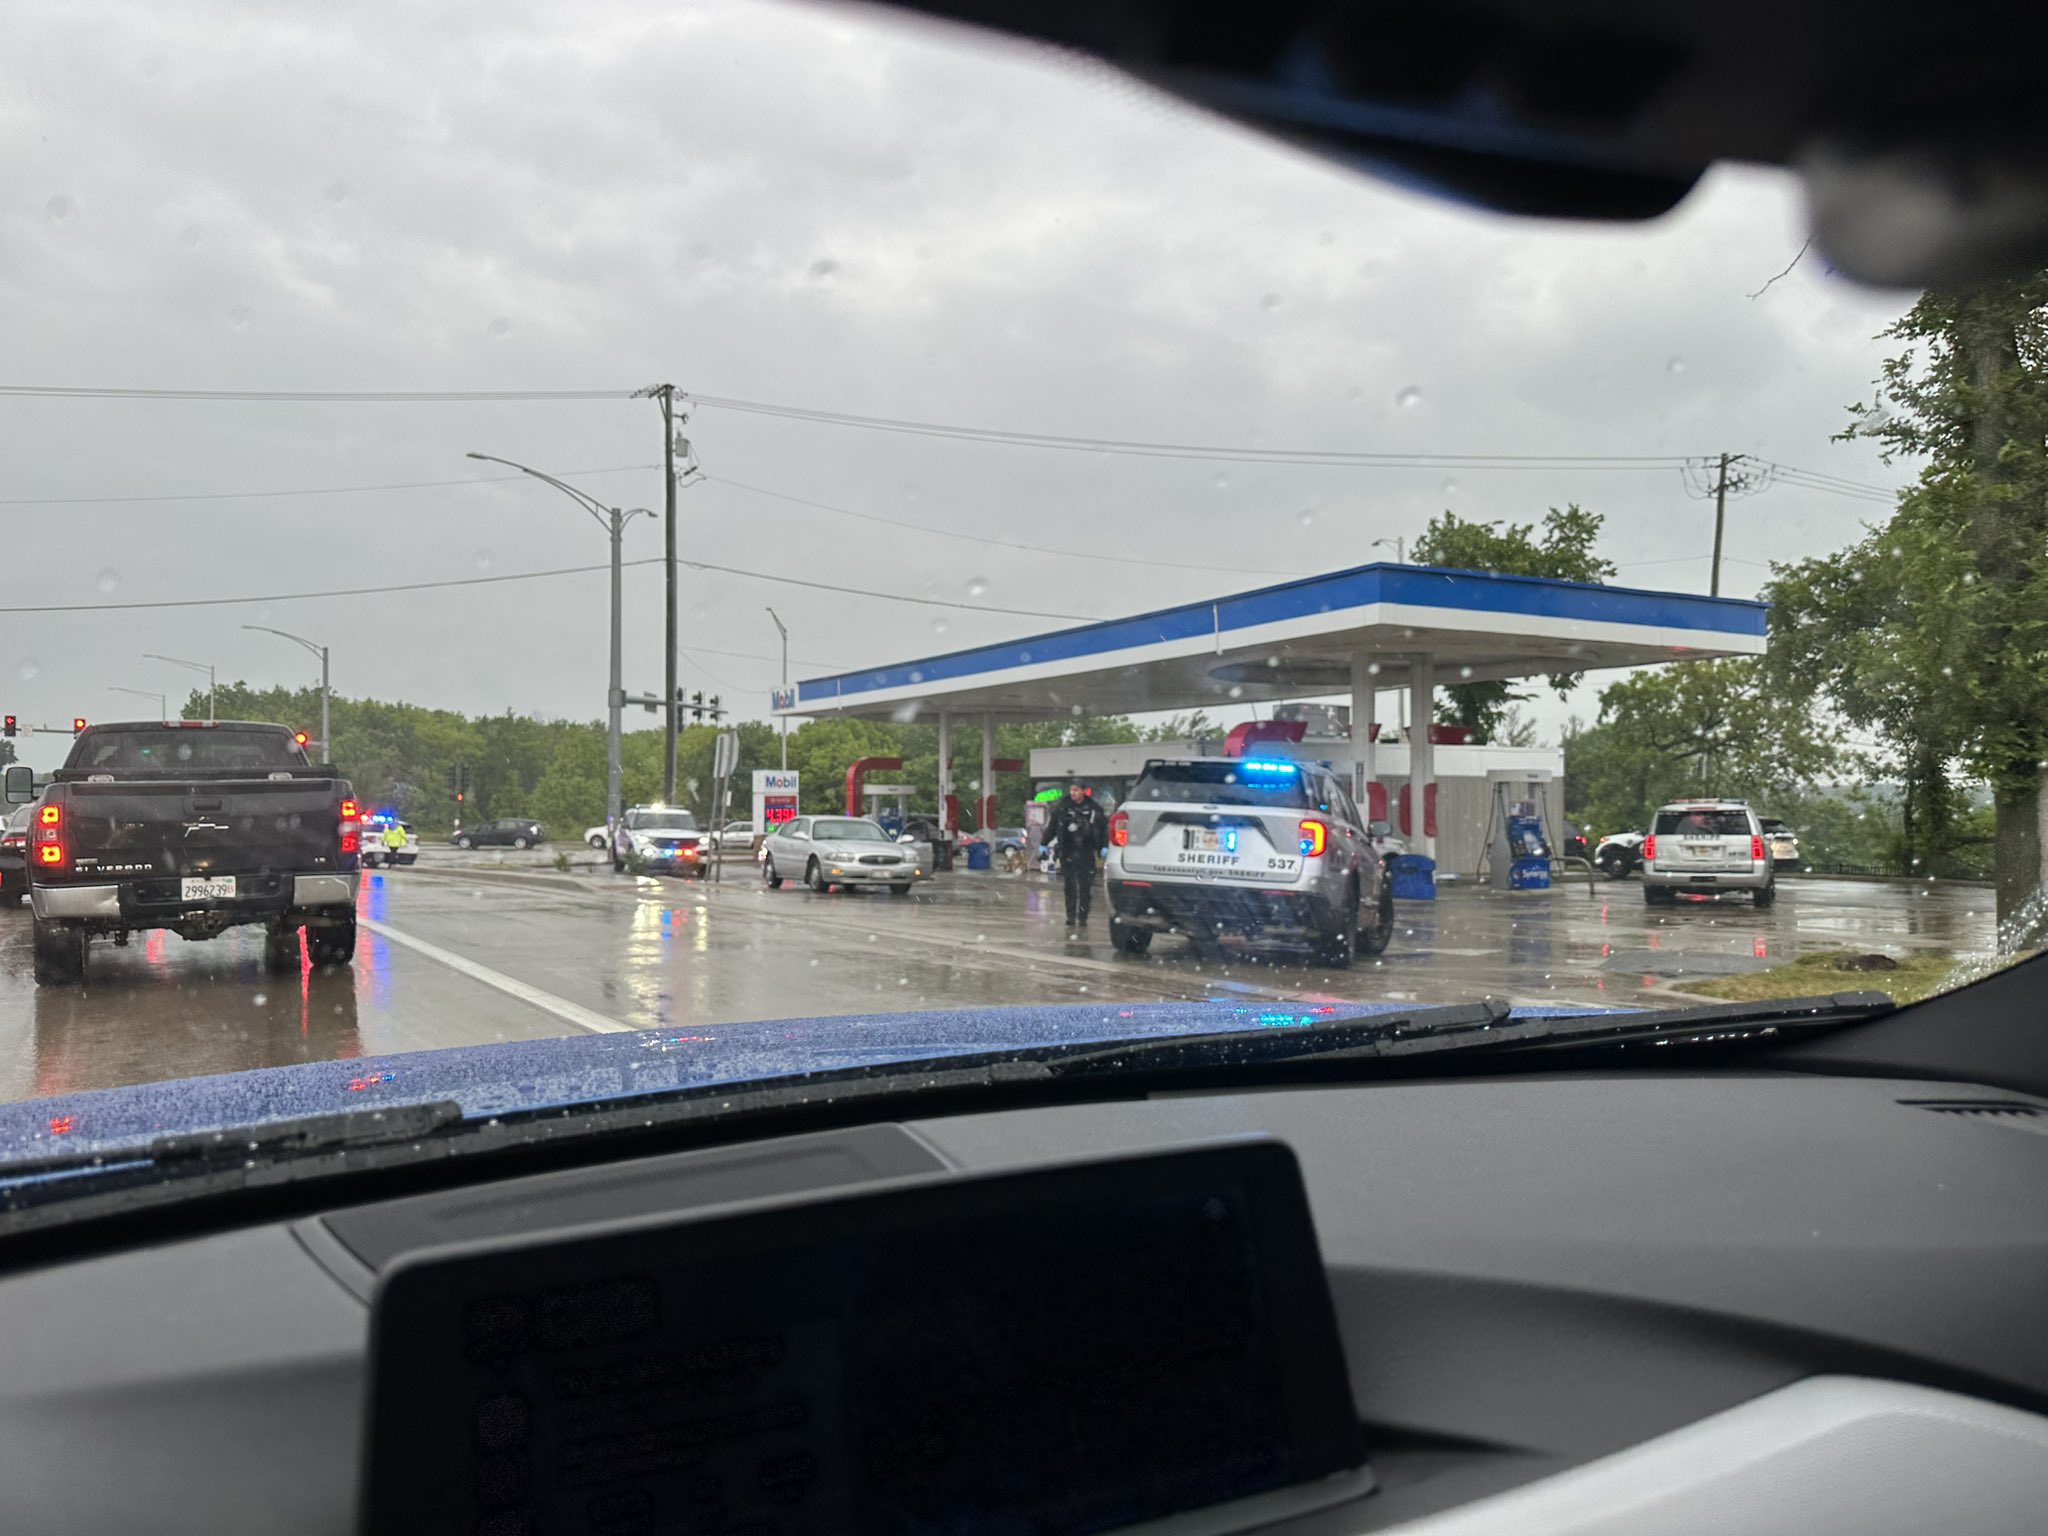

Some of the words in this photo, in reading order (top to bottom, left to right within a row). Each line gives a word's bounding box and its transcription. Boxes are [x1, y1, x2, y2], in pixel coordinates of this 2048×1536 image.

[772, 688, 795, 711] Mobil
[766, 775, 797, 788] Mobil
[1177, 853, 1240, 866] SHERIFF
[1267, 858, 1296, 870] 537
[1228, 870, 1266, 878] SHERIFF
[1522, 869, 1548, 880] Synergy
[184, 884, 227, 898] 2996239
